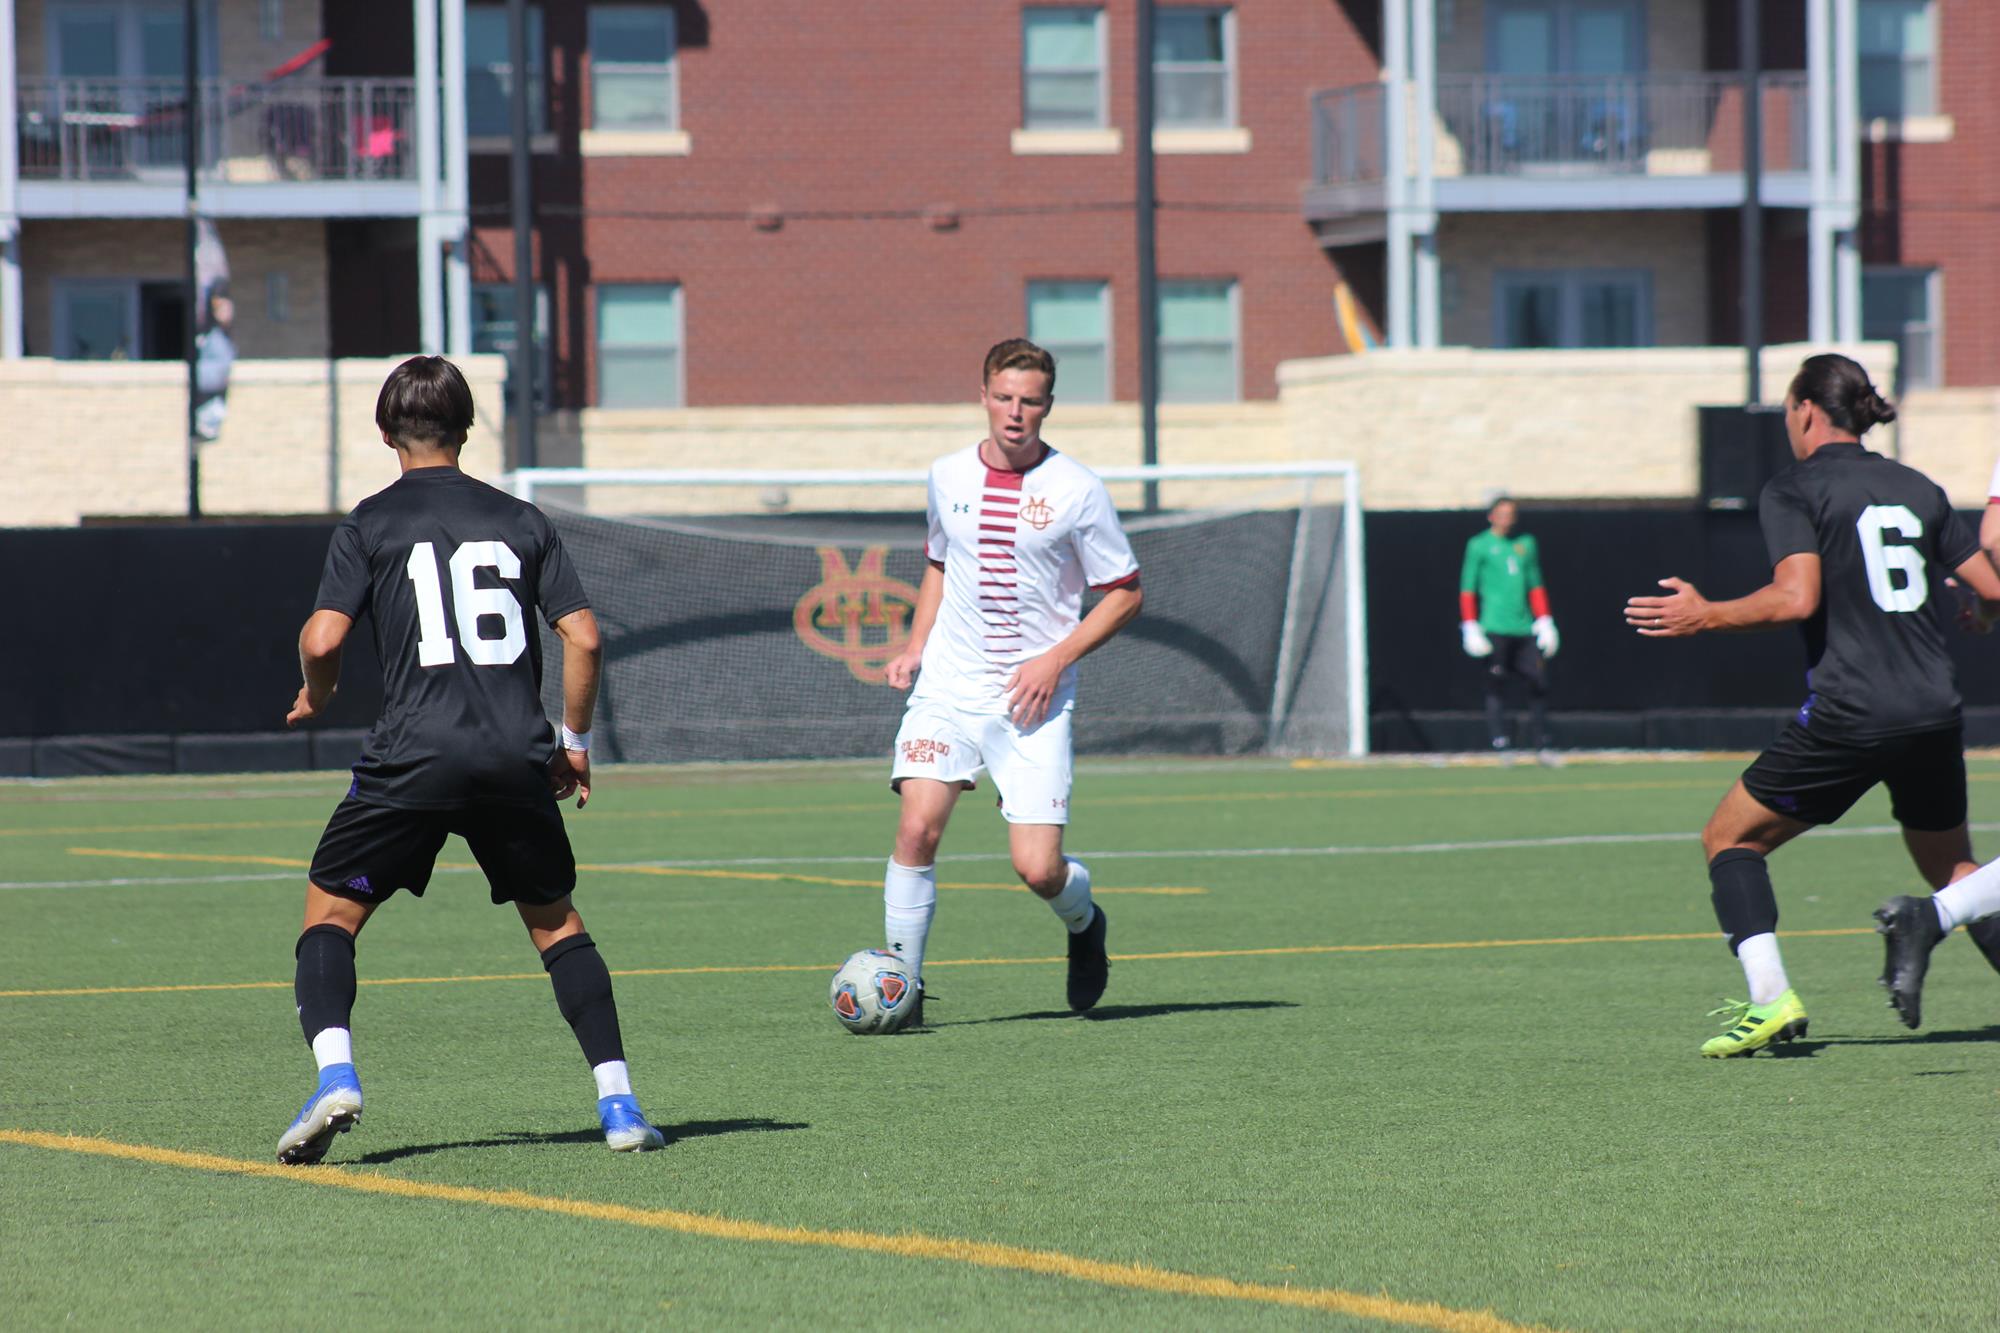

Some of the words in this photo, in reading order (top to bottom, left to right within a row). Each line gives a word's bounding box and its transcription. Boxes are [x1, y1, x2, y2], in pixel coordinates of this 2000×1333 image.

[406, 540, 527, 667] 16
[1856, 504, 1929, 613] 6
[904, 750, 935, 764] MESA
